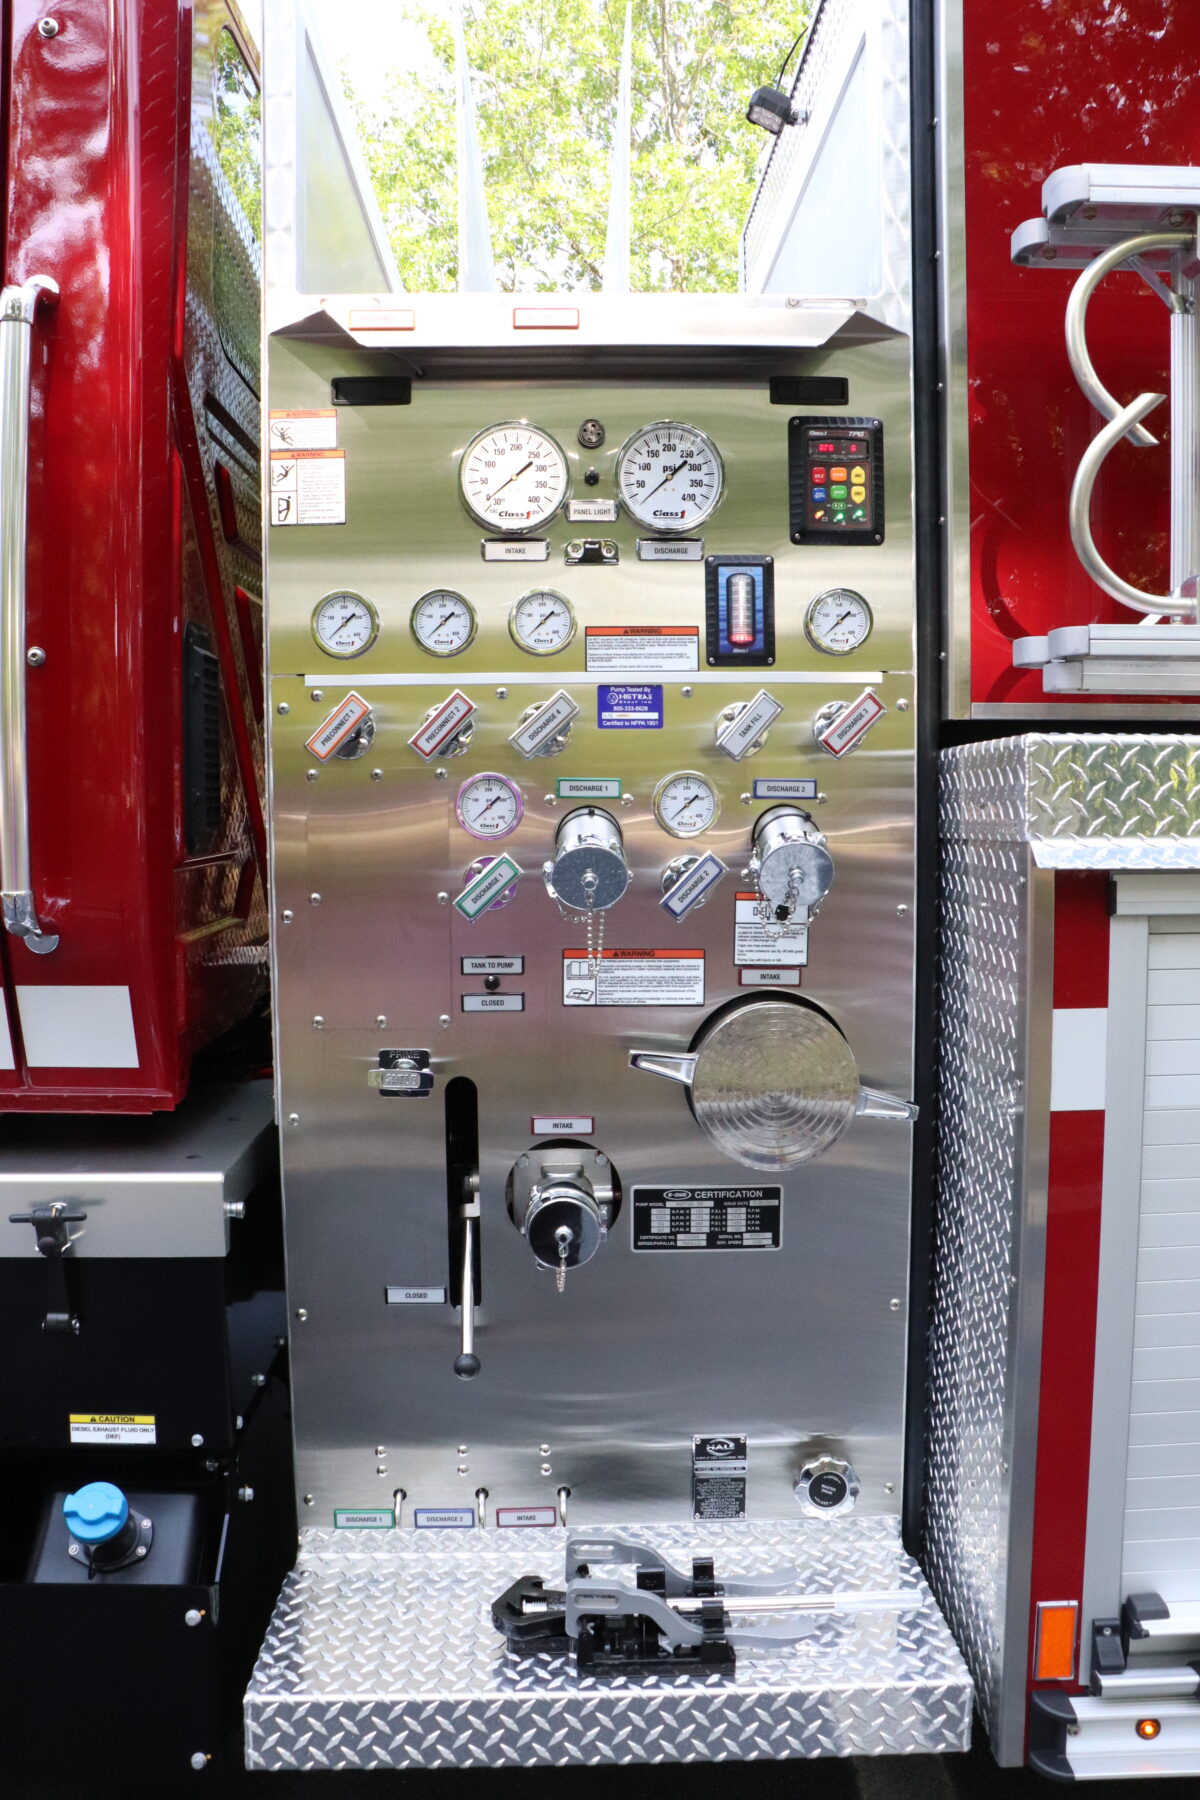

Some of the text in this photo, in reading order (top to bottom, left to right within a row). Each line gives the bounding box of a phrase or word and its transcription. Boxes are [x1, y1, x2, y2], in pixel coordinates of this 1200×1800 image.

[662, 444, 676, 452] 200
[646, 450, 660, 458] 150
[680, 450, 694, 458] 250
[638, 463, 651, 471] 100
[662, 464, 676, 473] psi
[688, 464, 702, 472] 300
[636, 480, 645, 488] 50
[690, 480, 703, 488] 350
[682, 494, 695, 502] 400
[321, 713, 351, 746] PRECONNECT
[425, 710, 456, 744] PRECONNECT
[528, 713, 557, 741] DISCHARGE
[738, 714, 762, 739] TANK FILL
[836, 713, 864, 740] DISCHARGE
[471, 877, 500, 904] DISCHARGE
[678, 876, 704, 903] DISCHARGE
[390, 1050, 420, 1058] PRIME
[695, 1190, 762, 1199] CERTIFICATION
